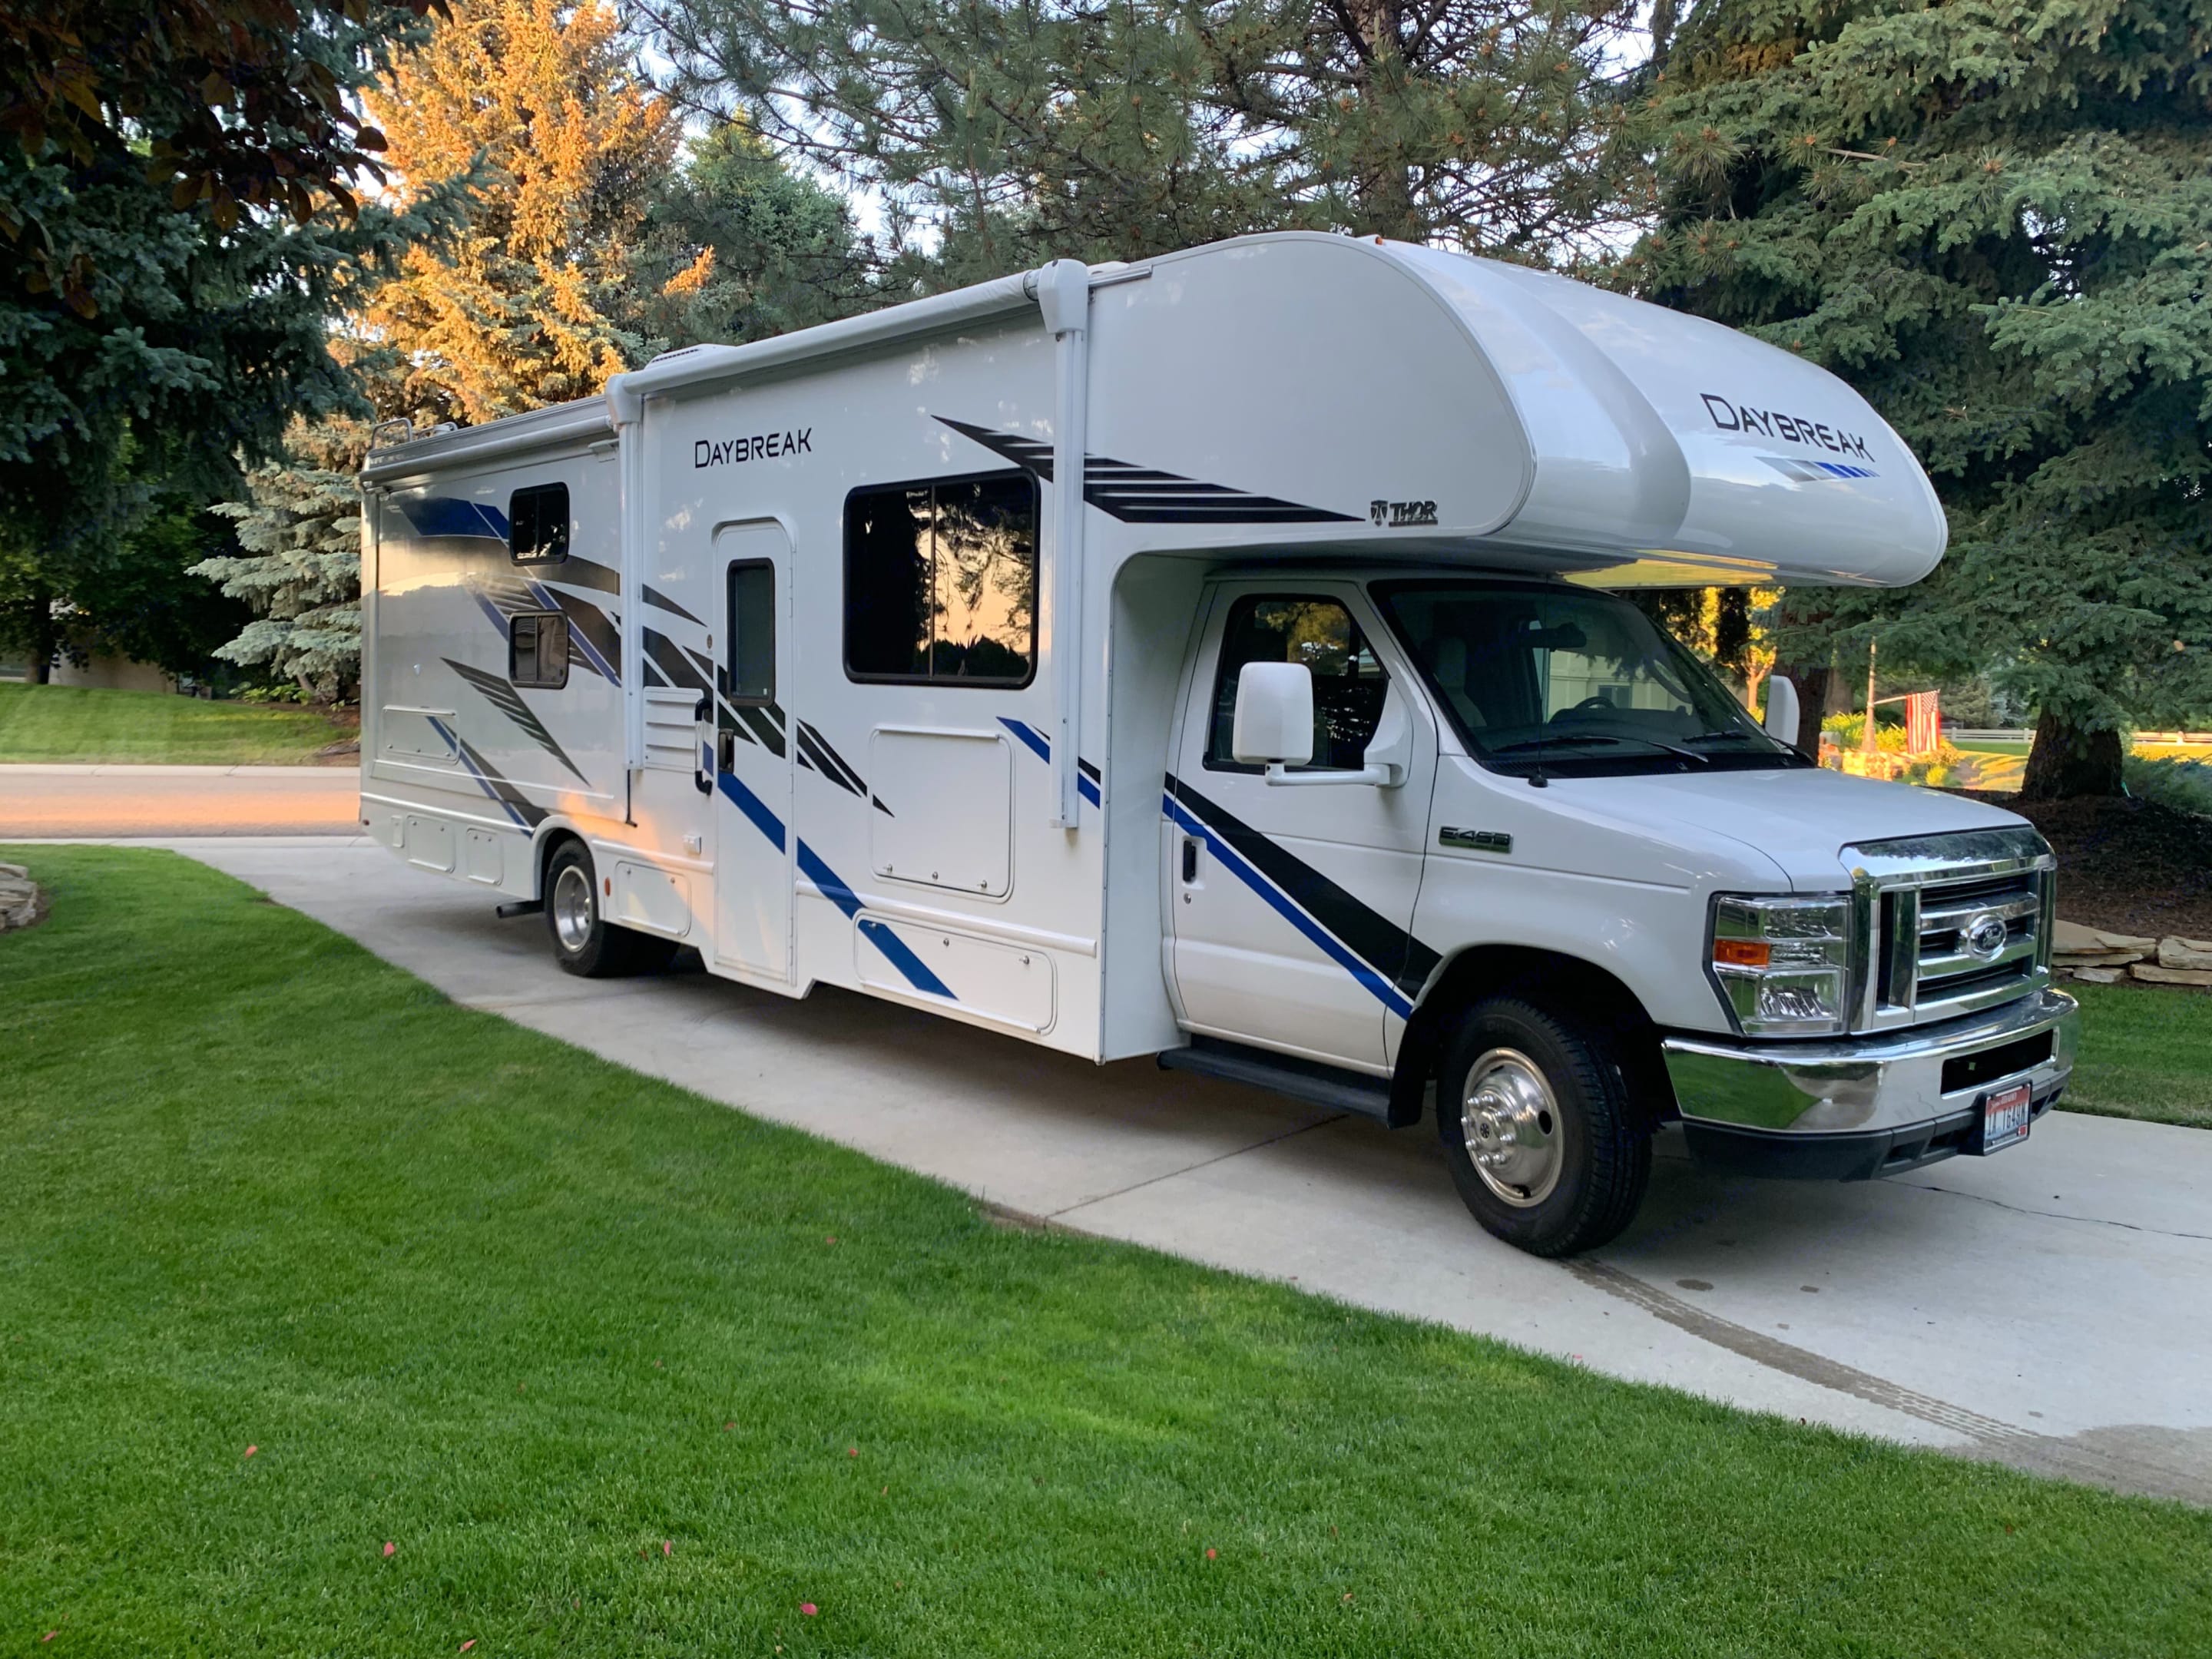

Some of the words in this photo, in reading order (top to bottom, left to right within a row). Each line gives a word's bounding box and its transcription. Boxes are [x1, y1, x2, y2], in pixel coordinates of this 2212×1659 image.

[694, 427, 813, 469] DAYBREAK
[1699, 392, 1876, 462] DAYBREAK
[1389, 501, 1438, 521] THOR
